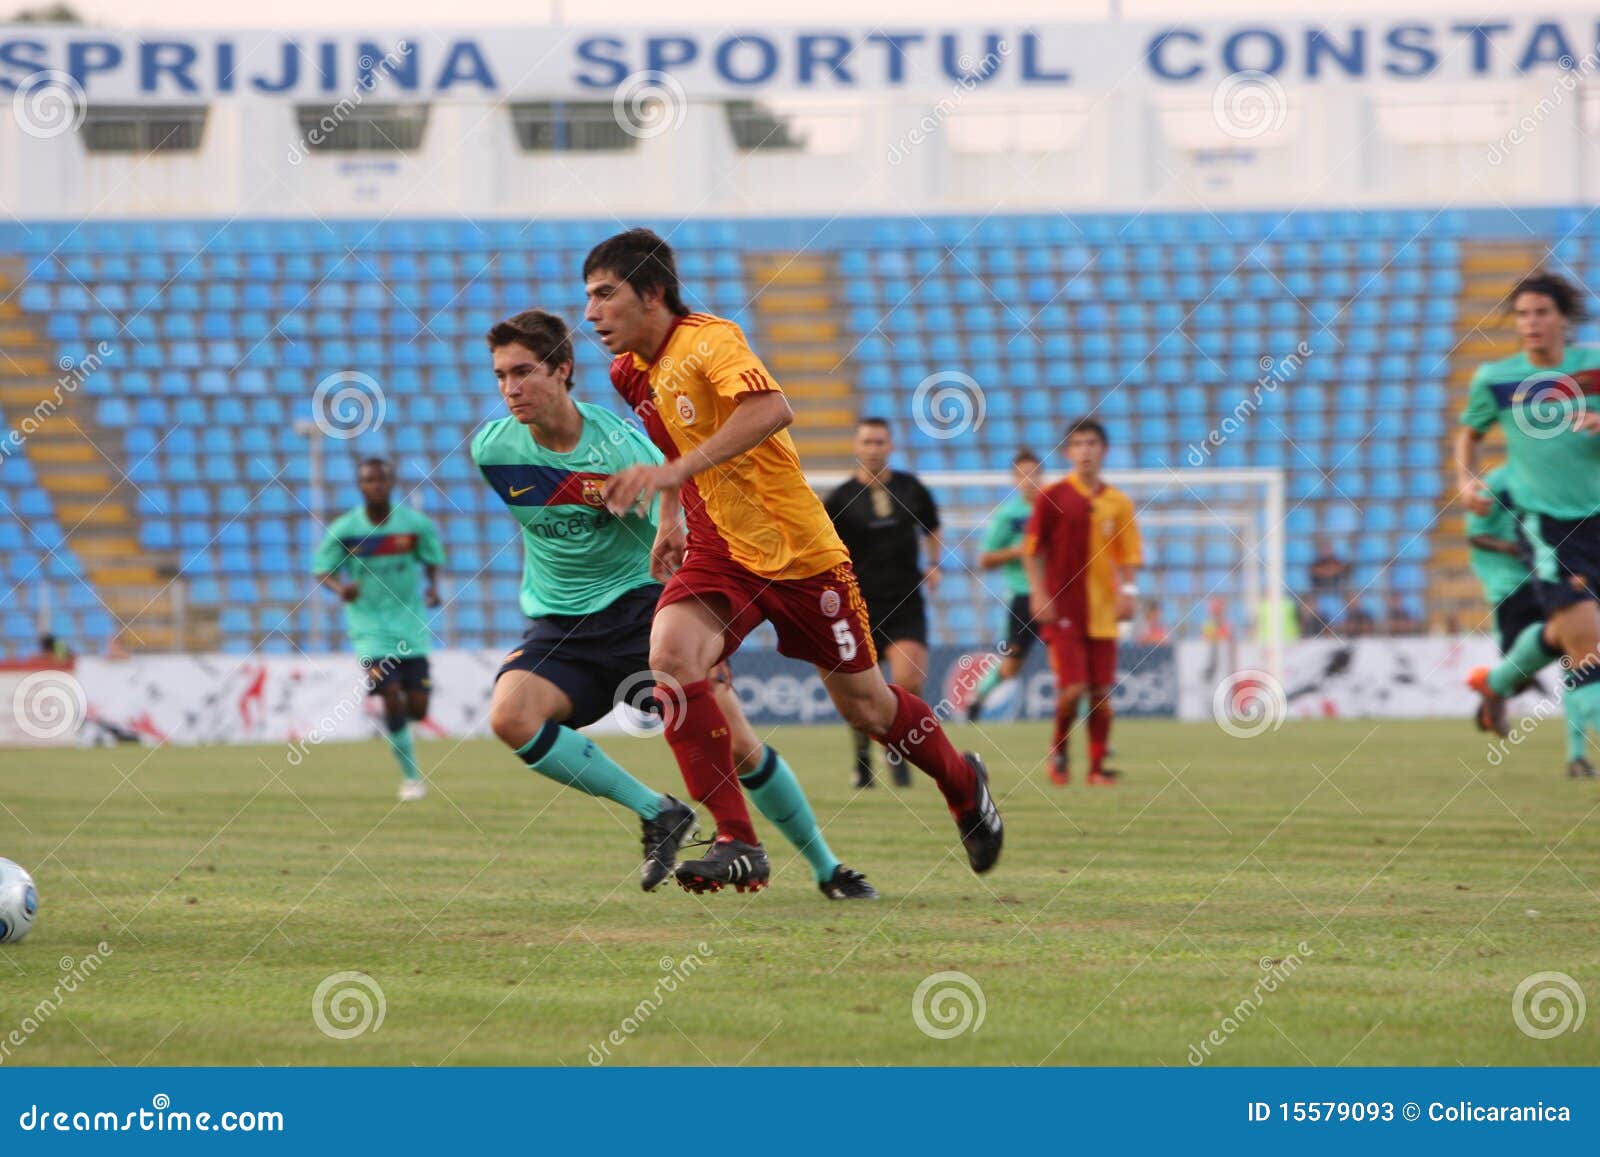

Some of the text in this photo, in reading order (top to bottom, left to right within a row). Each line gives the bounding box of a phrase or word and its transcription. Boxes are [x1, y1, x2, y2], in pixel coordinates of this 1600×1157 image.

[0, 22, 1600, 94] SPRIJINA SPORTUL CONSTA
[831, 618, 857, 661] 5
